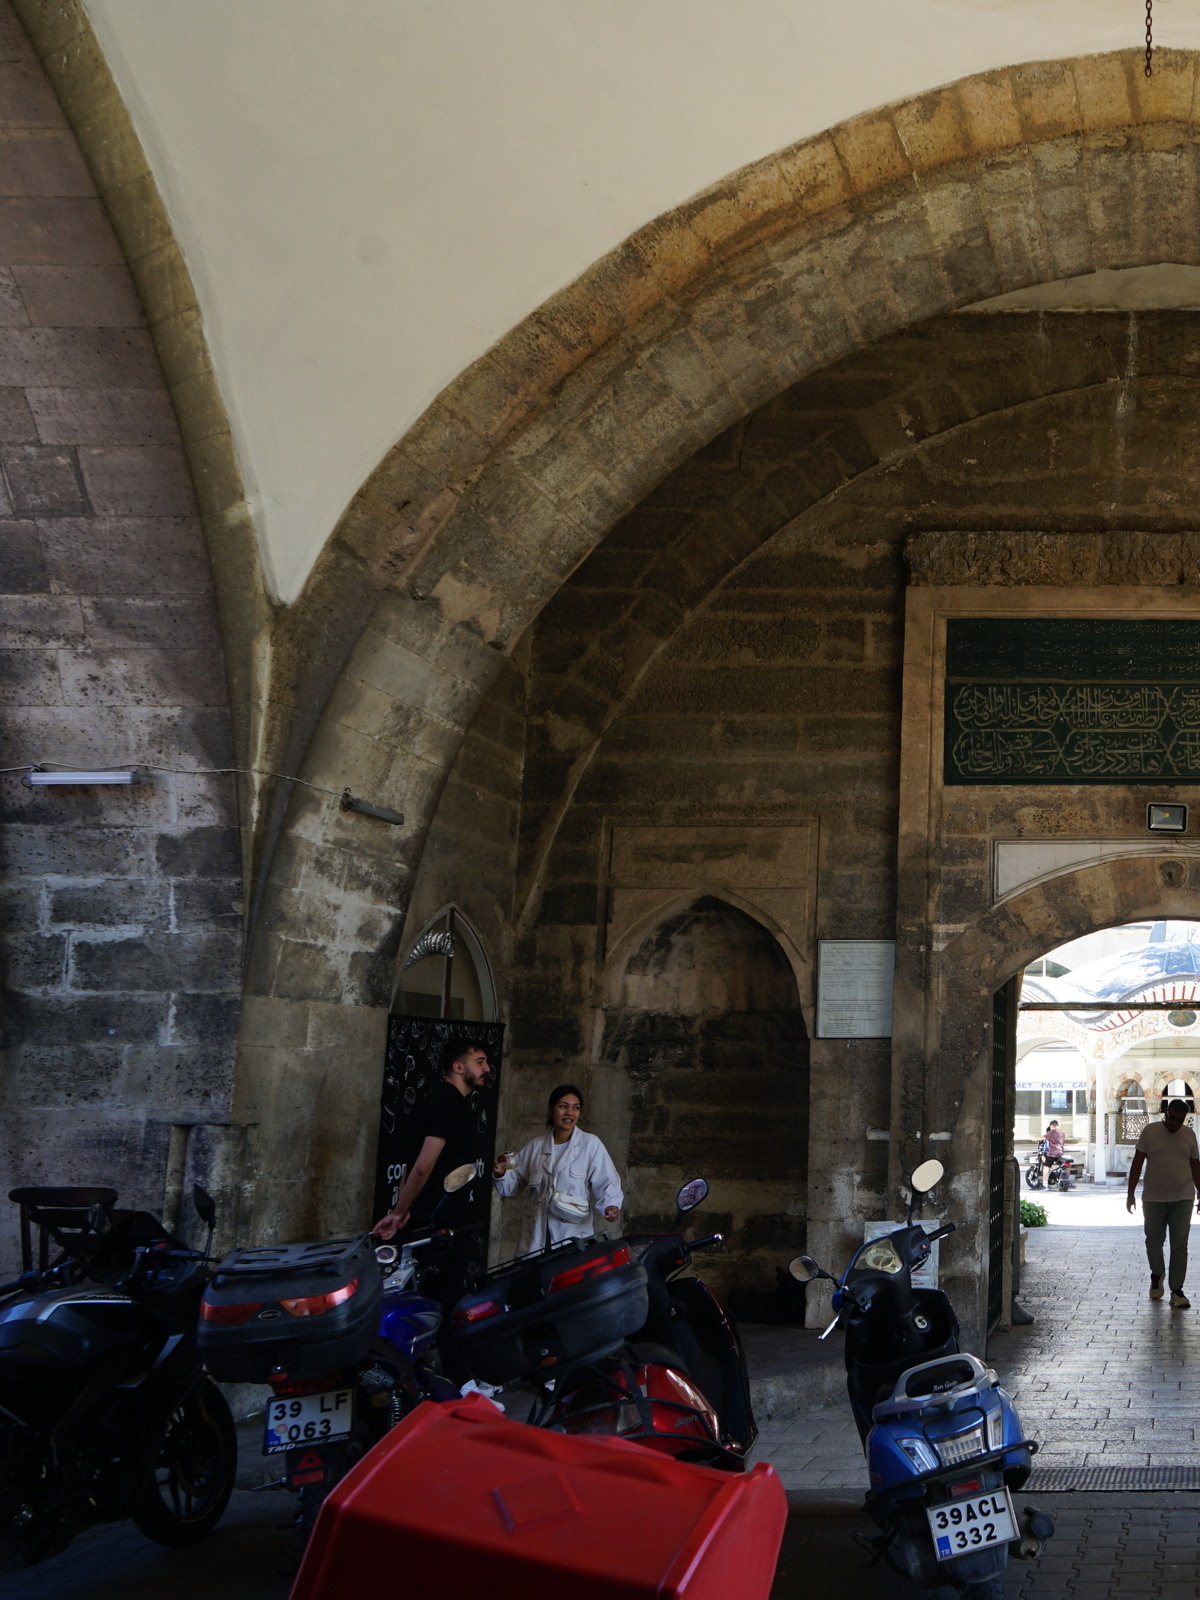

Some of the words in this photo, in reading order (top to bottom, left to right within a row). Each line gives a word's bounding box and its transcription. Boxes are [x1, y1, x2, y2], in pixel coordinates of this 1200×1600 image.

[274, 1401, 302, 1421] 39
[320, 1392, 349, 1413] LF
[288, 1418, 332, 1442] 063
[268, 1443, 296, 1454] TMD
[935, 1496, 1006, 1529] 39ACL
[955, 1522, 998, 1549] 332
[941, 1548, 950, 1557] TR
